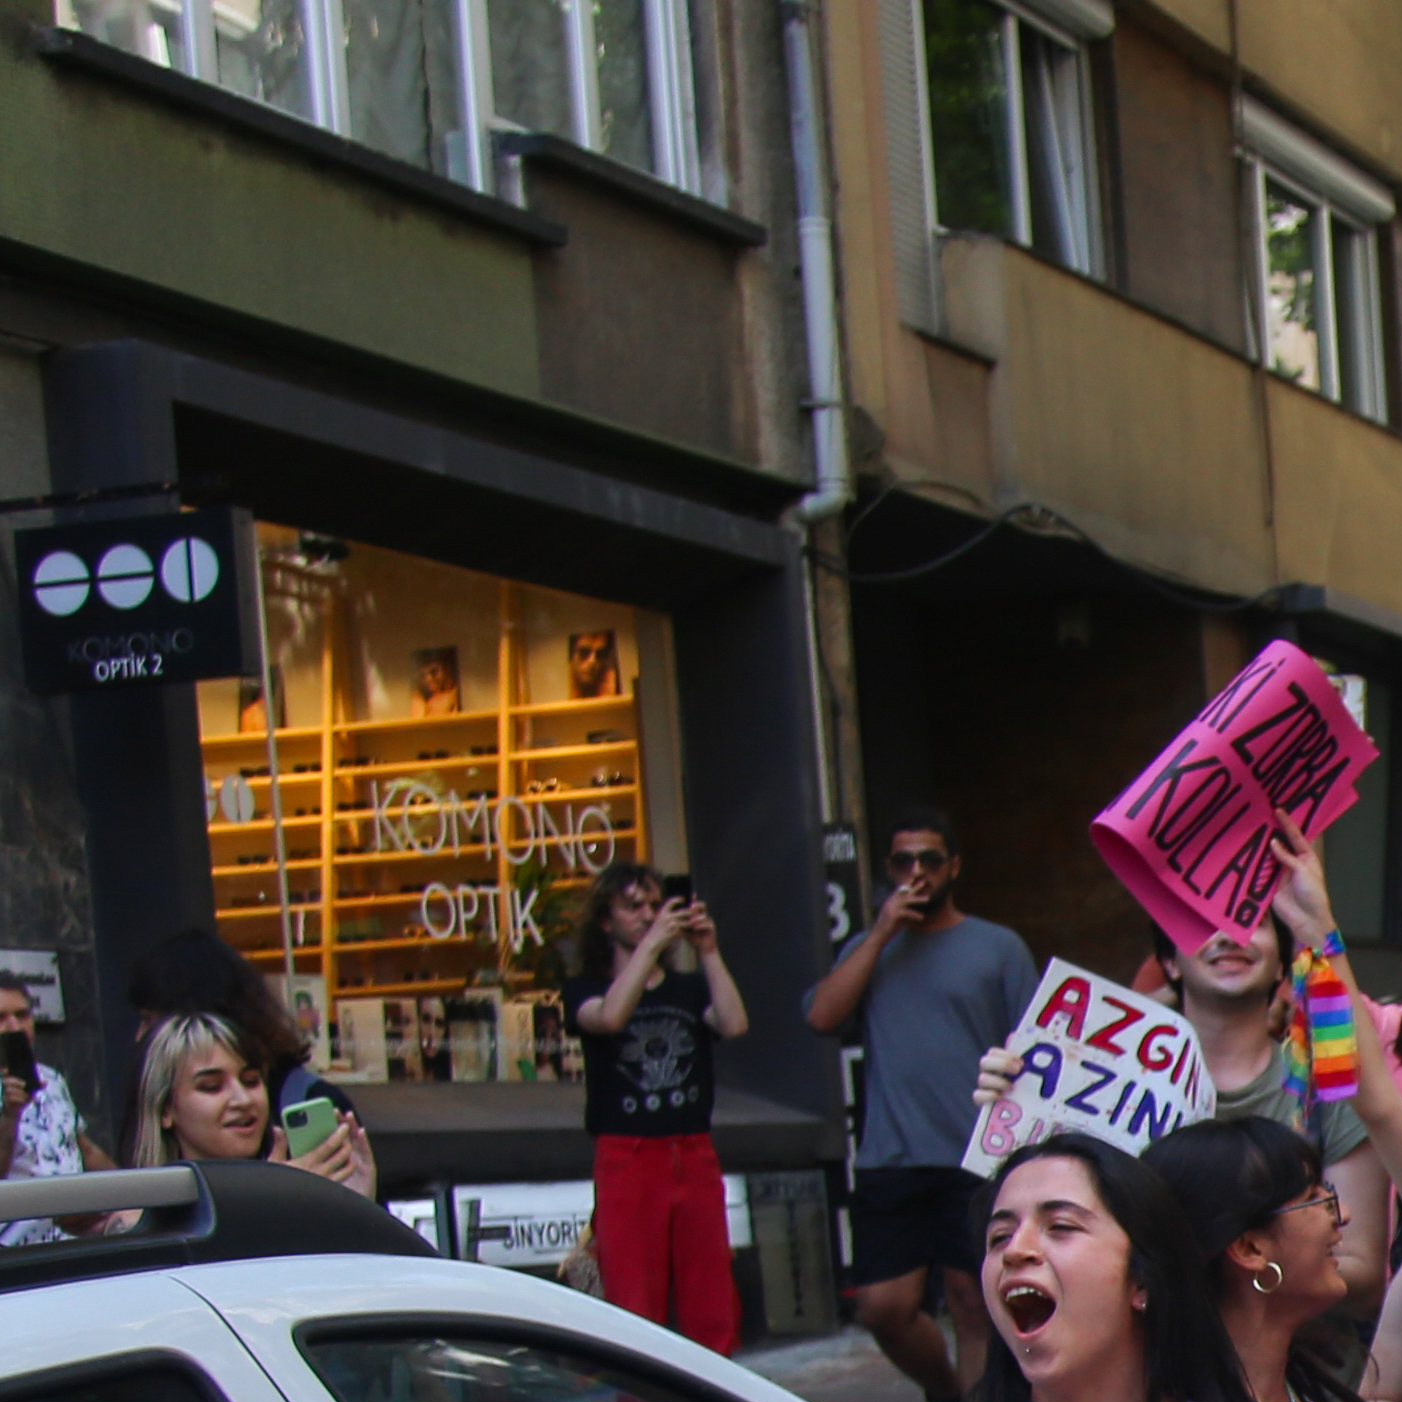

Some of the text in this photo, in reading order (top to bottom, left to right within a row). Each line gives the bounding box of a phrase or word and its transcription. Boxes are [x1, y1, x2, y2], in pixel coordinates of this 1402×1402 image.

[94, 653, 163, 682] OPTİK 2
[370, 780, 614, 873] KOMONO
